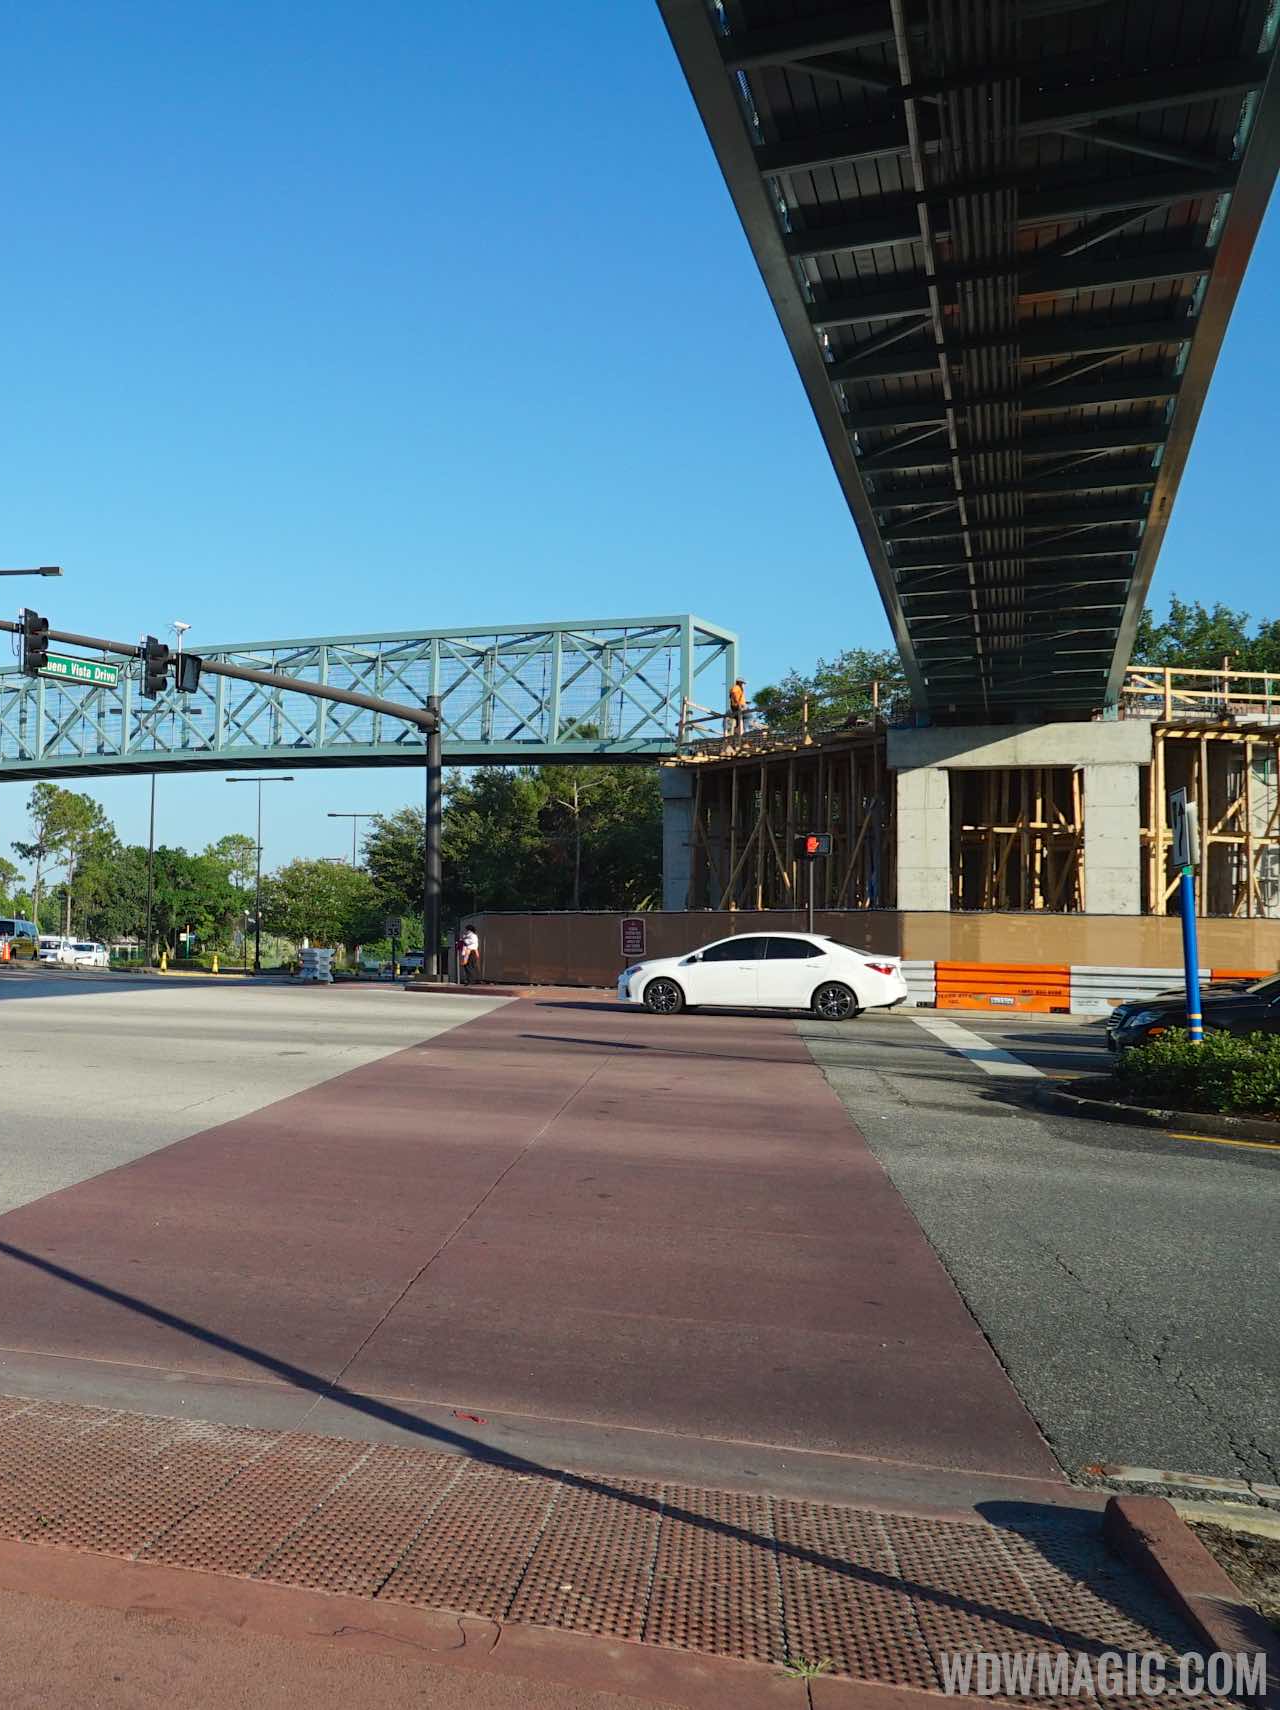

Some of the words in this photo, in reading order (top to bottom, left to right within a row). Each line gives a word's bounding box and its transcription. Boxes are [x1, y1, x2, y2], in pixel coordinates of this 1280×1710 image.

[42, 661, 67, 673] uena
[71, 662, 91, 678] Vista
[94, 667, 116, 683] Drive
[387, 928, 400, 936] 35
